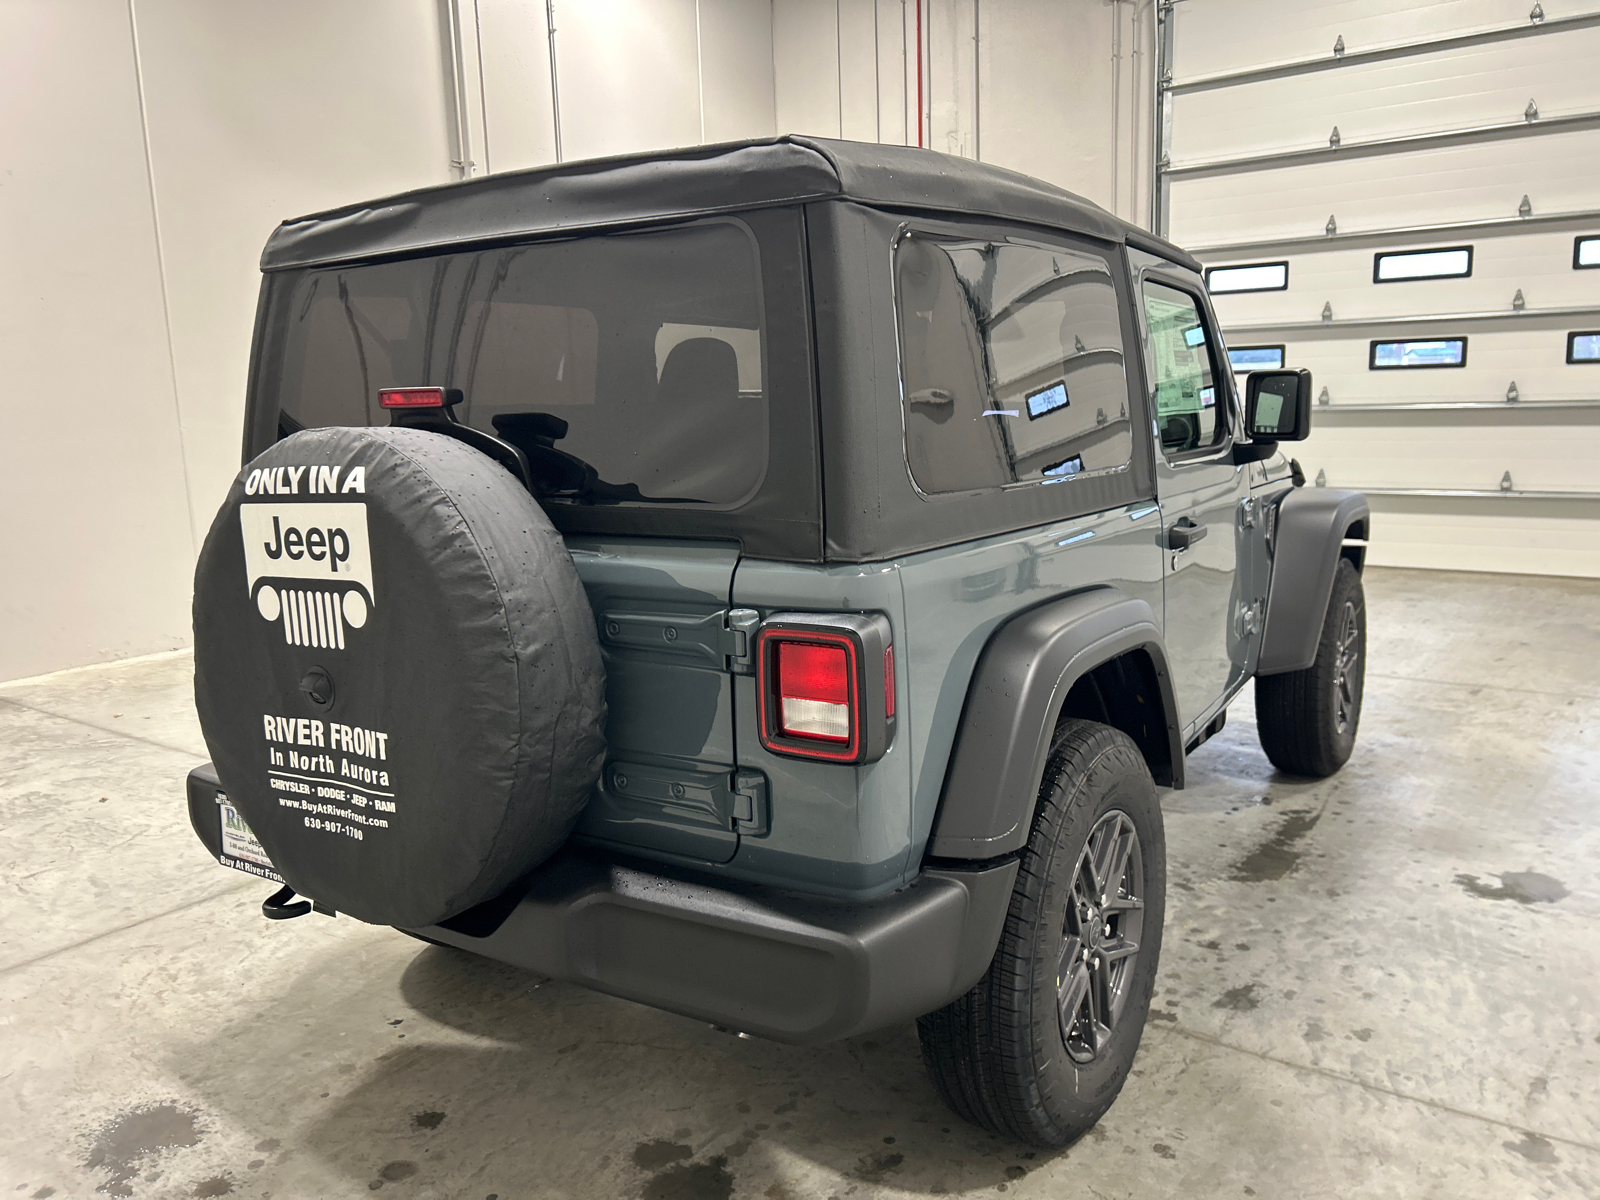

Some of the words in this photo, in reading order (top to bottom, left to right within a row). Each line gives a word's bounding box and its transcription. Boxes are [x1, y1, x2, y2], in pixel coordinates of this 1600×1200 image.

[245, 466, 306, 495] ONLY
[308, 465, 341, 494] IN
[341, 466, 366, 494] A
[264, 515, 350, 572] Jeep
[263, 714, 325, 747] RIVER
[330, 722, 388, 760] FRONT
[270, 747, 284, 766] In
[289, 750, 335, 774] North
[341, 758, 389, 786] Aurora
[270, 778, 310, 794] CHRYSLER
[317, 786, 346, 801] DODGE
[351, 793, 368, 807] JEEP
[374, 799, 396, 813] RAM
[279, 798, 388, 828] www.BuyAtRiverFront.com
[304, 817, 363, 841] 630-907-1700
[220, 855, 235, 868] Buy
[235, 859, 245, 870] At
[245, 862, 265, 876] River
[265, 868, 286, 883] Fron
